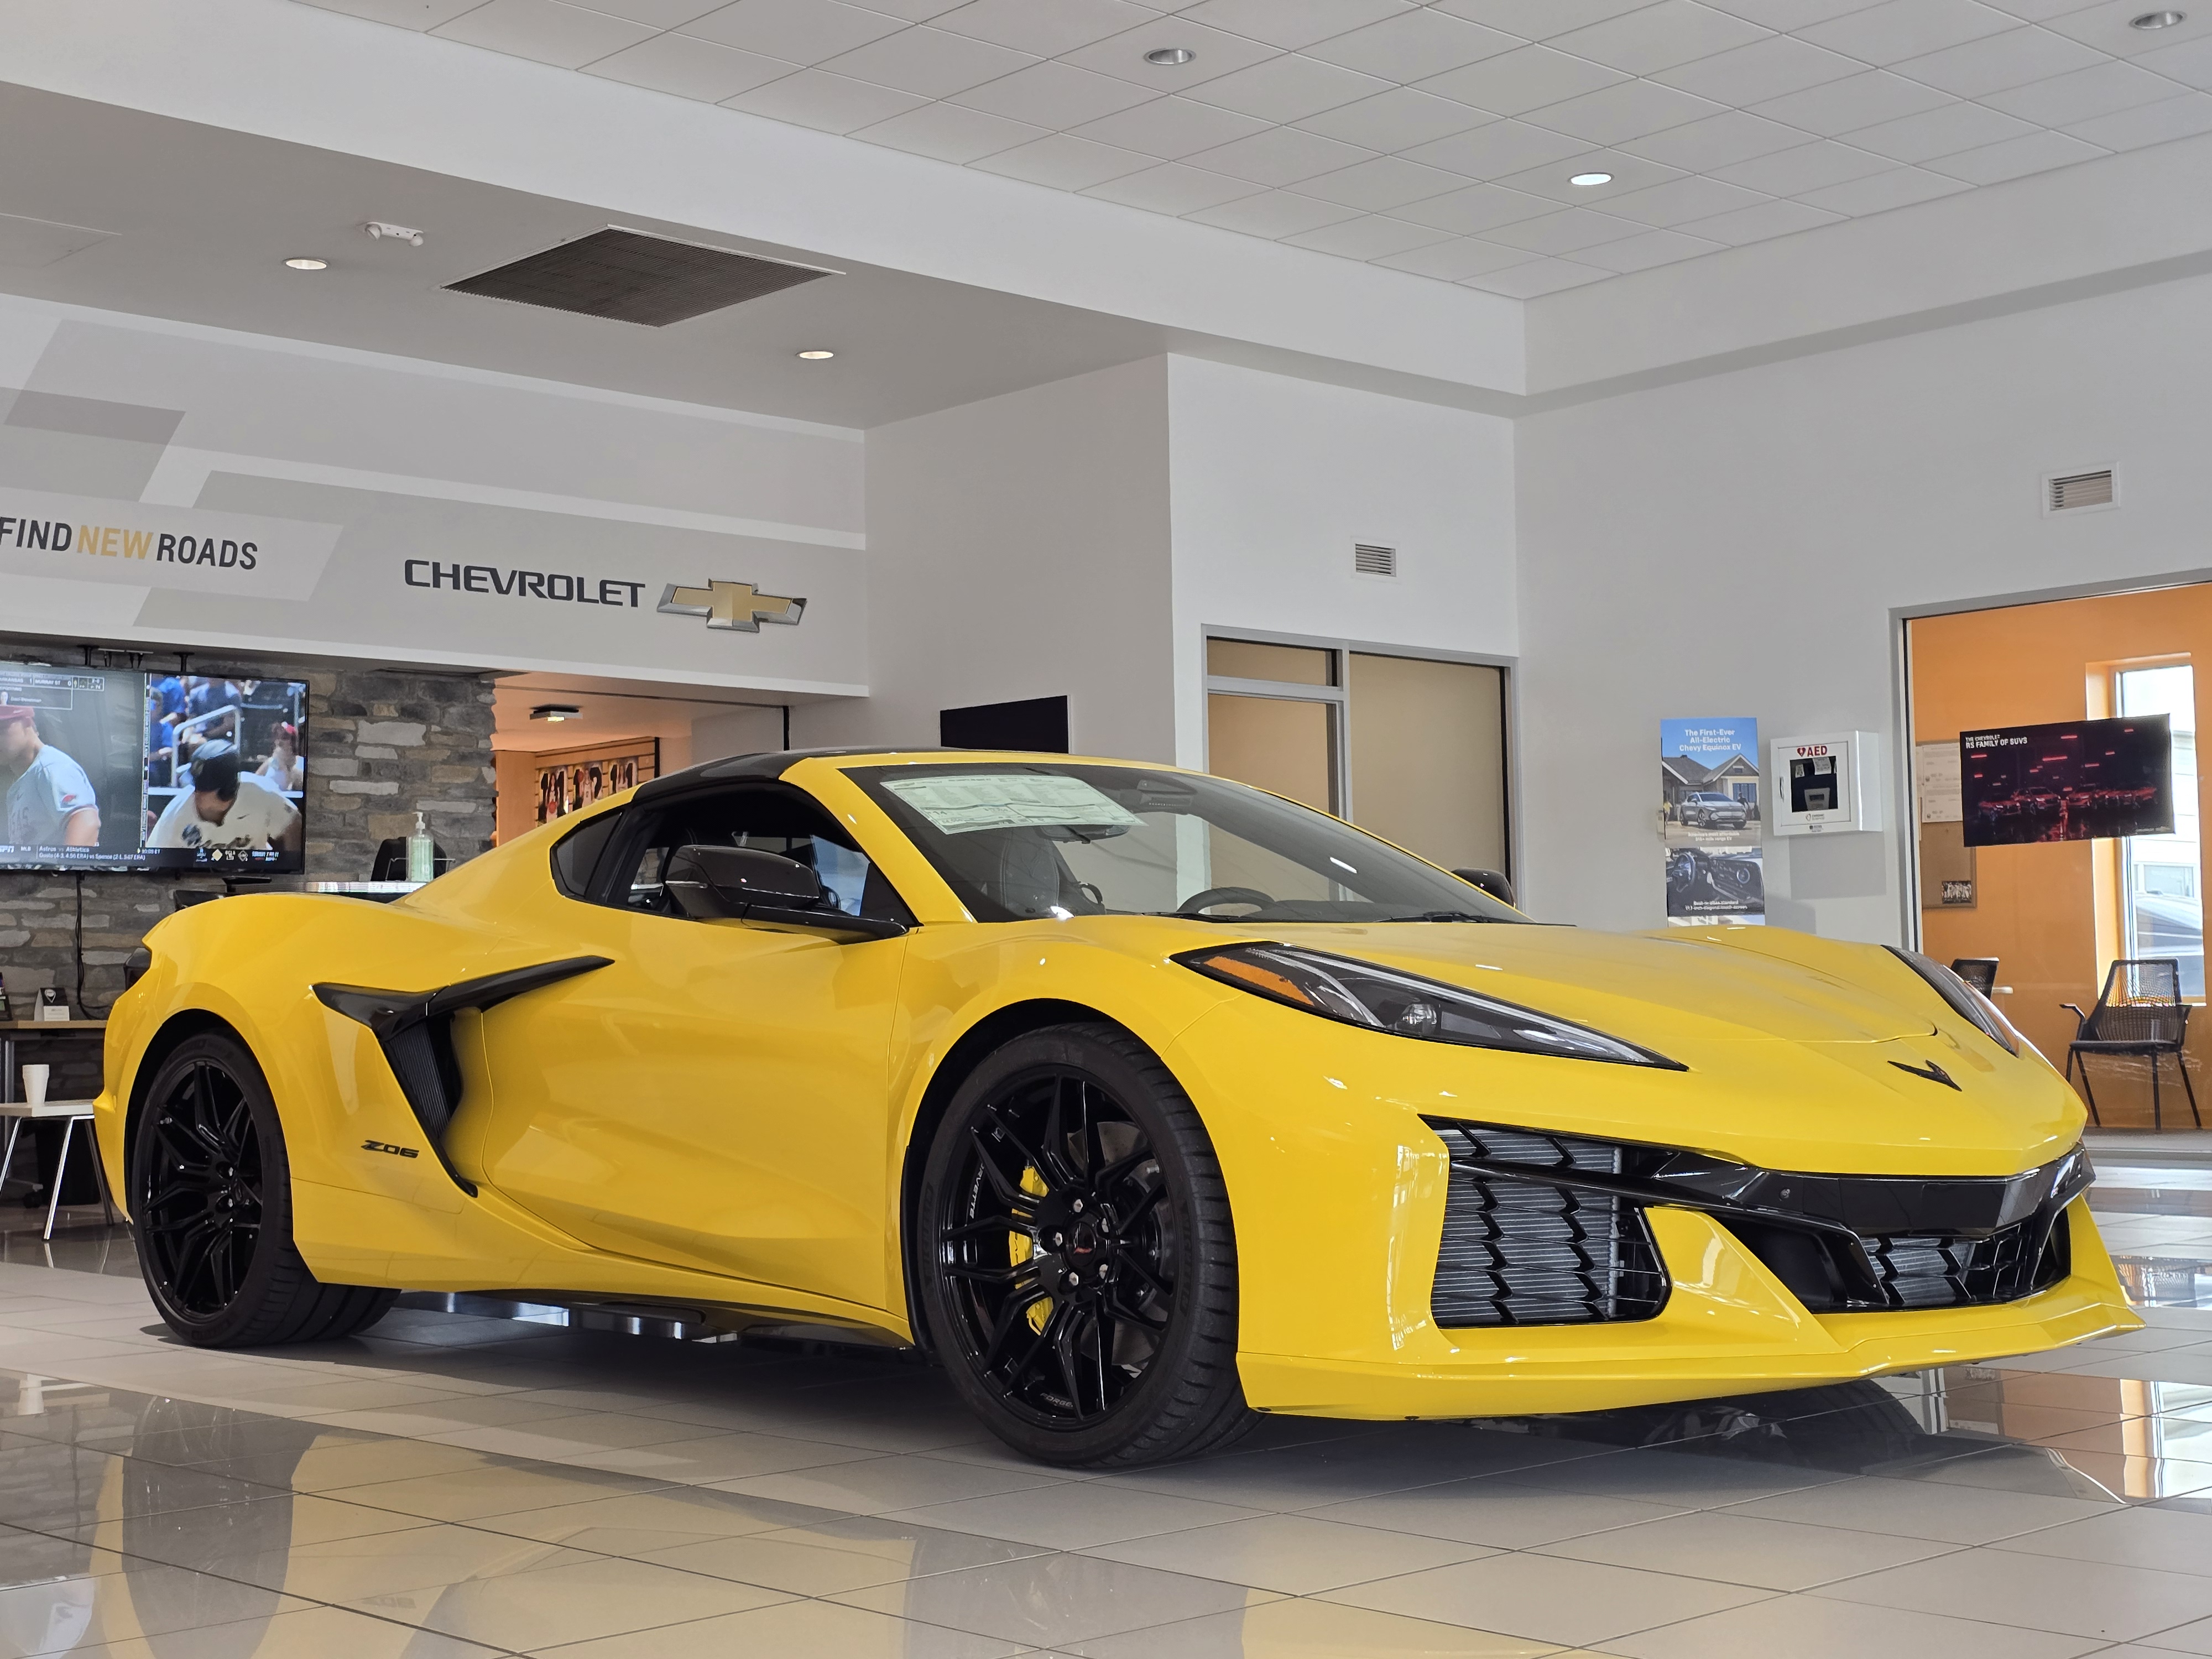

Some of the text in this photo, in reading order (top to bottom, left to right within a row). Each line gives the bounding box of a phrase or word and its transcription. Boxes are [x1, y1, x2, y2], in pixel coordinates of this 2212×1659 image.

[0, 517, 258, 570] FIND NEW ROADS
[404, 559, 646, 608] CHEVROLET
[1679, 744, 1701, 752] Chevy
[1702, 743, 1731, 752] Equinox
[1807, 745, 1828, 757] AED
[1976, 740, 1999, 748] FAMILY
[361, 1140, 420, 1159] Z06
[969, 1162, 985, 1219] RVETTE
[1040, 1392, 1073, 1408] FORGE
